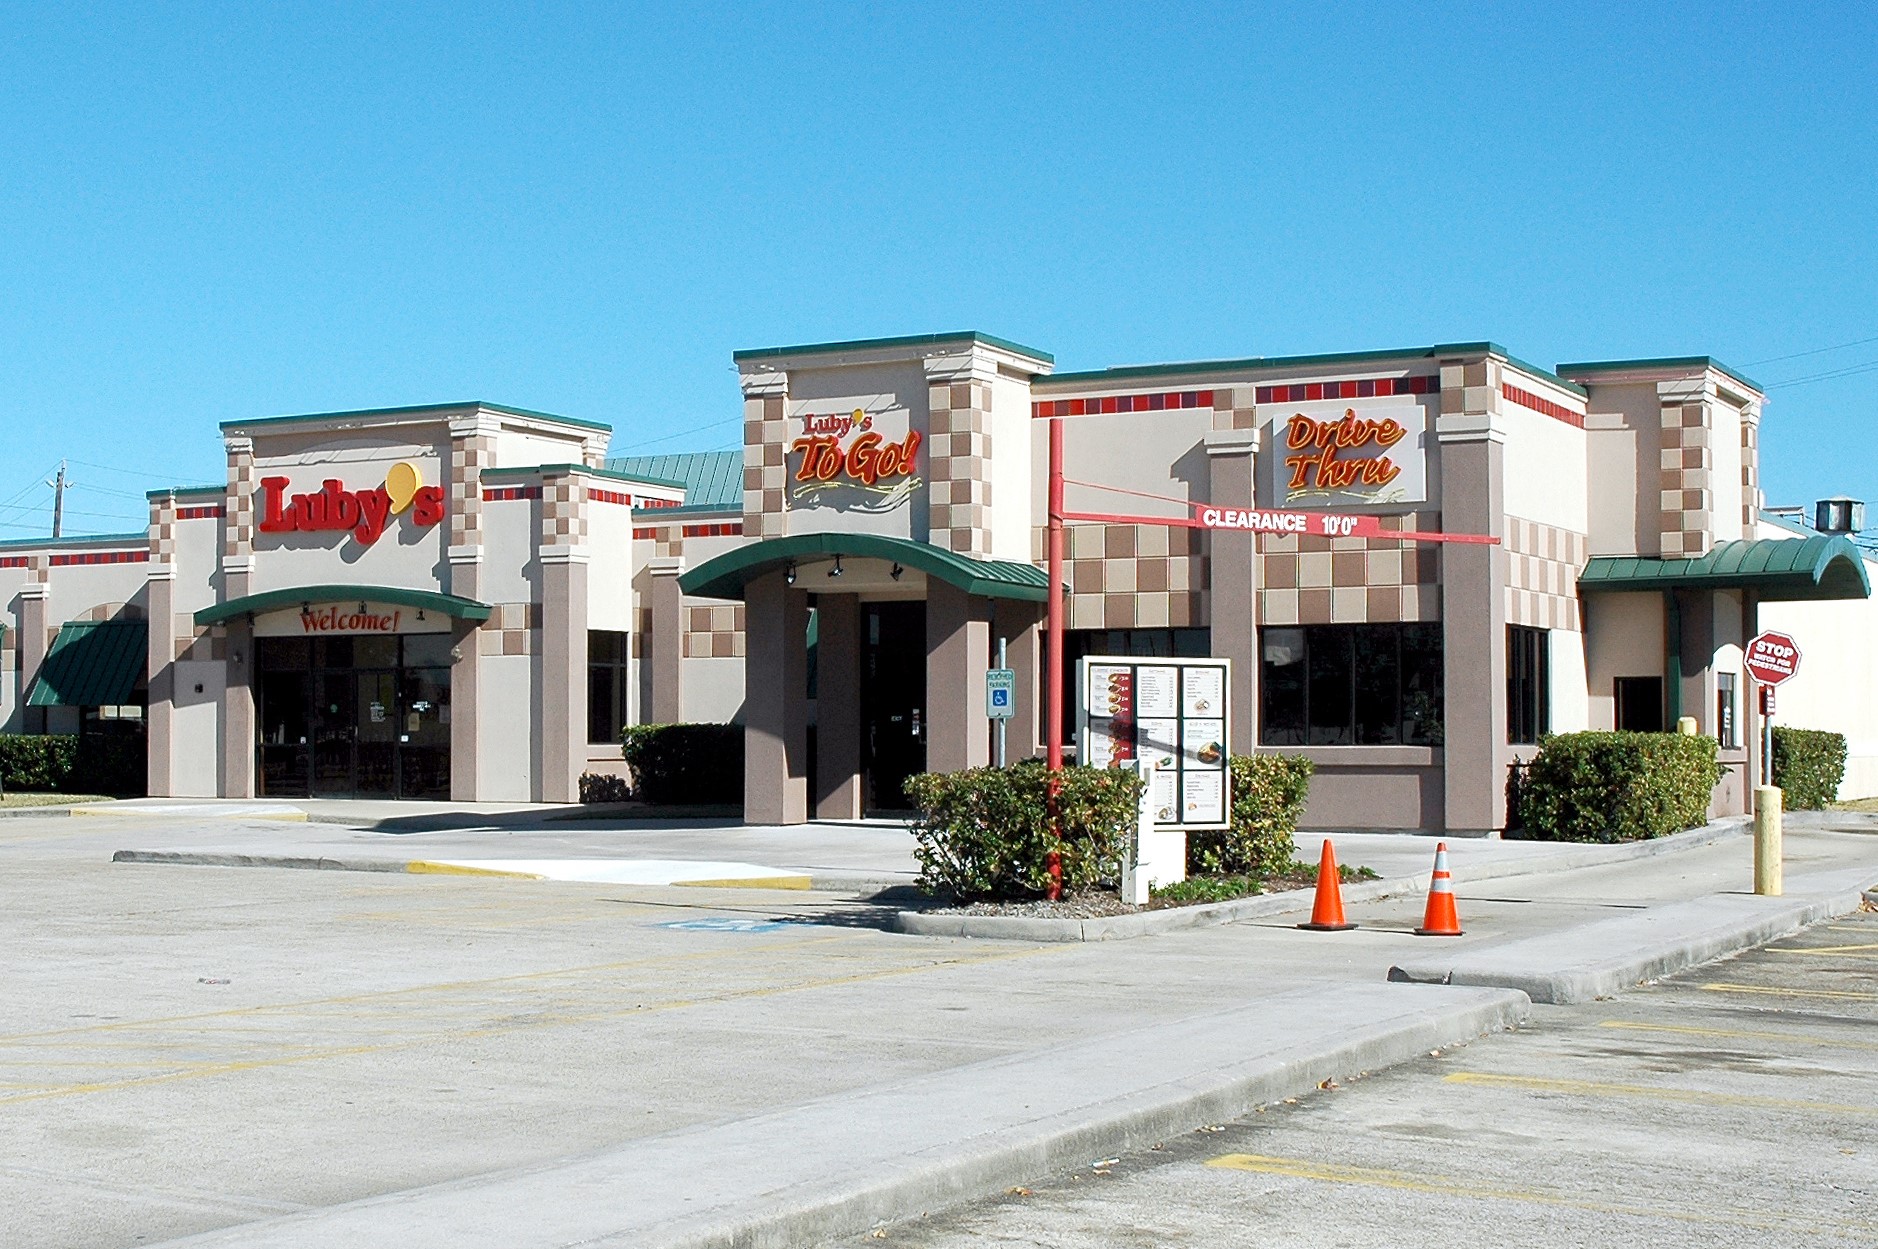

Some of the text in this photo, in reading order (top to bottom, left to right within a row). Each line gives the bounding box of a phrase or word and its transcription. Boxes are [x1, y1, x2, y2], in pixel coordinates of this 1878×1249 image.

[802, 407, 873, 438] Luby's
[1286, 408, 1407, 449] Drive
[845, 429, 922, 485] Go!
[1285, 444, 1401, 489] Thru
[259, 462, 445, 545] Luby's
[1203, 509, 1358, 535] CLEARANCE 10'0"
[301, 607, 401, 633] Welcome!
[1756, 641, 1794, 658] STOP
